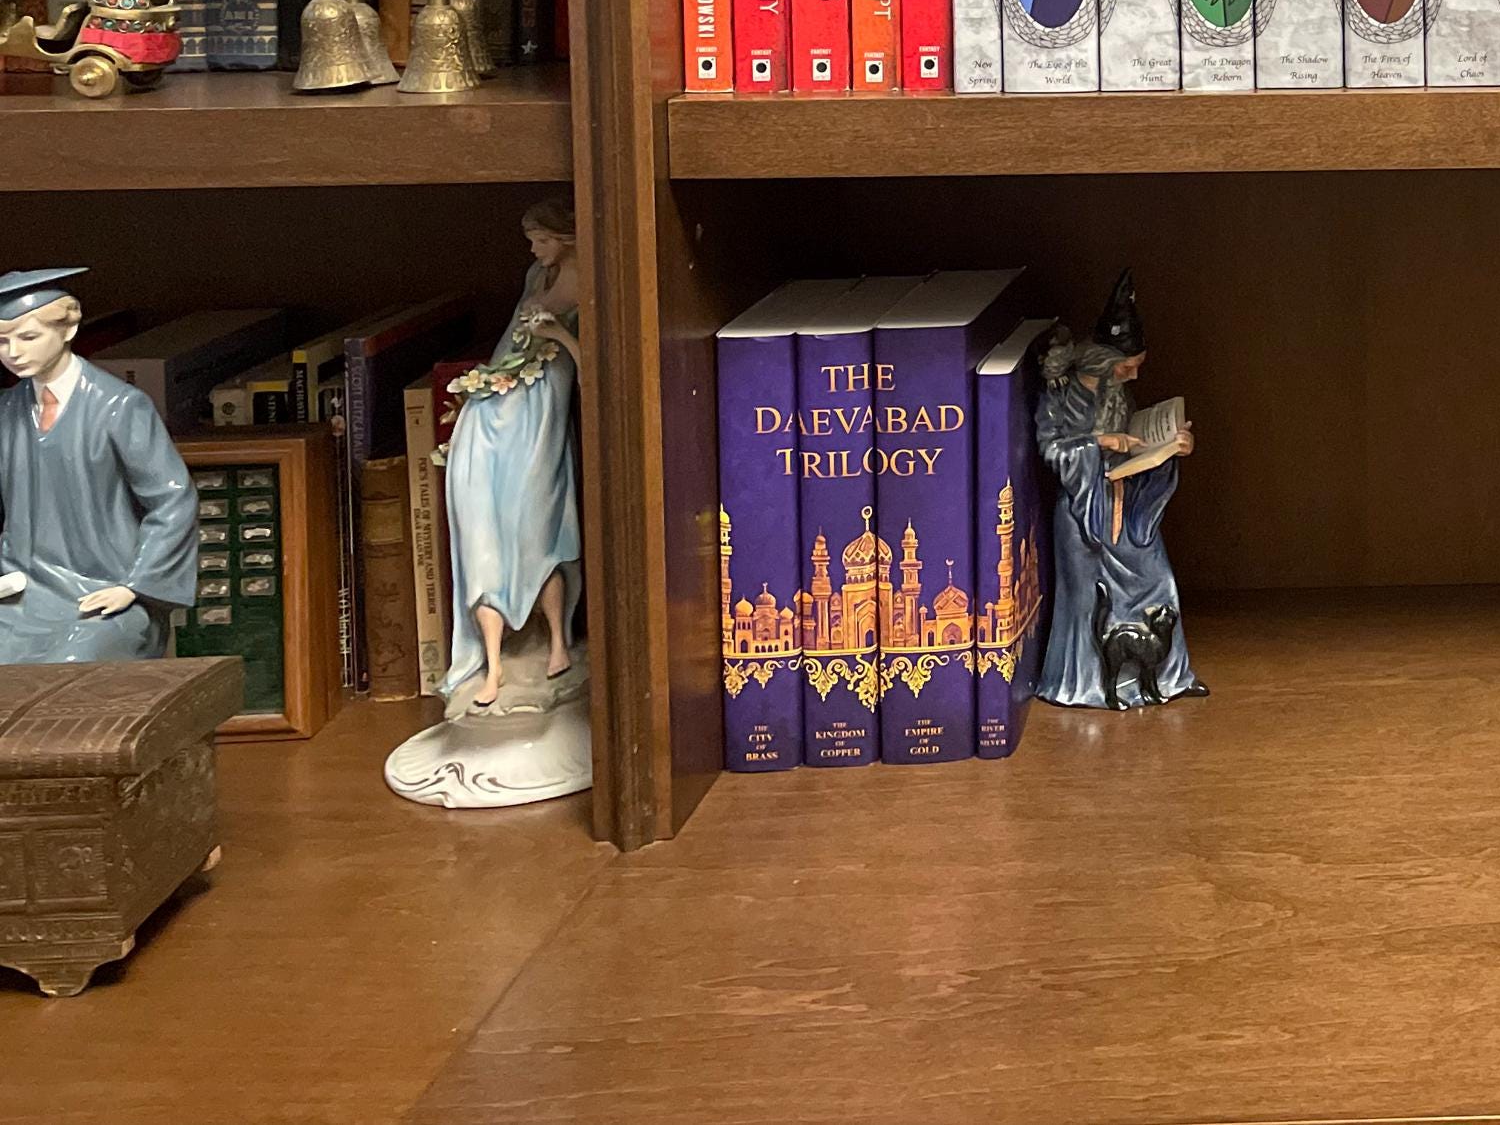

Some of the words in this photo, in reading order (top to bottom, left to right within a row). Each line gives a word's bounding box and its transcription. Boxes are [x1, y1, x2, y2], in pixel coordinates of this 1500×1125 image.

[1131, 58, 1146, 67] The
[1148, 58, 1172, 67] Great
[1201, 58, 1216, 67] The
[1217, 58, 1251, 68] Dragon
[1280, 55, 1295, 64] The
[1296, 55, 1329, 64] Shadow
[973, 60, 992, 69] New
[968, 77, 997, 86] Spring
[1044, 76, 1071, 85] World
[1139, 75, 1163, 83] Hunt
[1212, 73, 1243, 82] Reborn
[1289, 72, 1318, 83] Rising
[821, 362, 896, 393] THE
[754, 404, 965, 436] DAEVABAD
[776, 447, 944, 479] TRILOGY
[815, 729, 865, 739] KINGDOM
[905, 727, 944, 737] EMPIRE
[748, 734, 774, 742] CITY
[820, 748, 861, 757] COPPER
[909, 746, 940, 755] GOLD
[745, 752, 778, 761] BRASS
